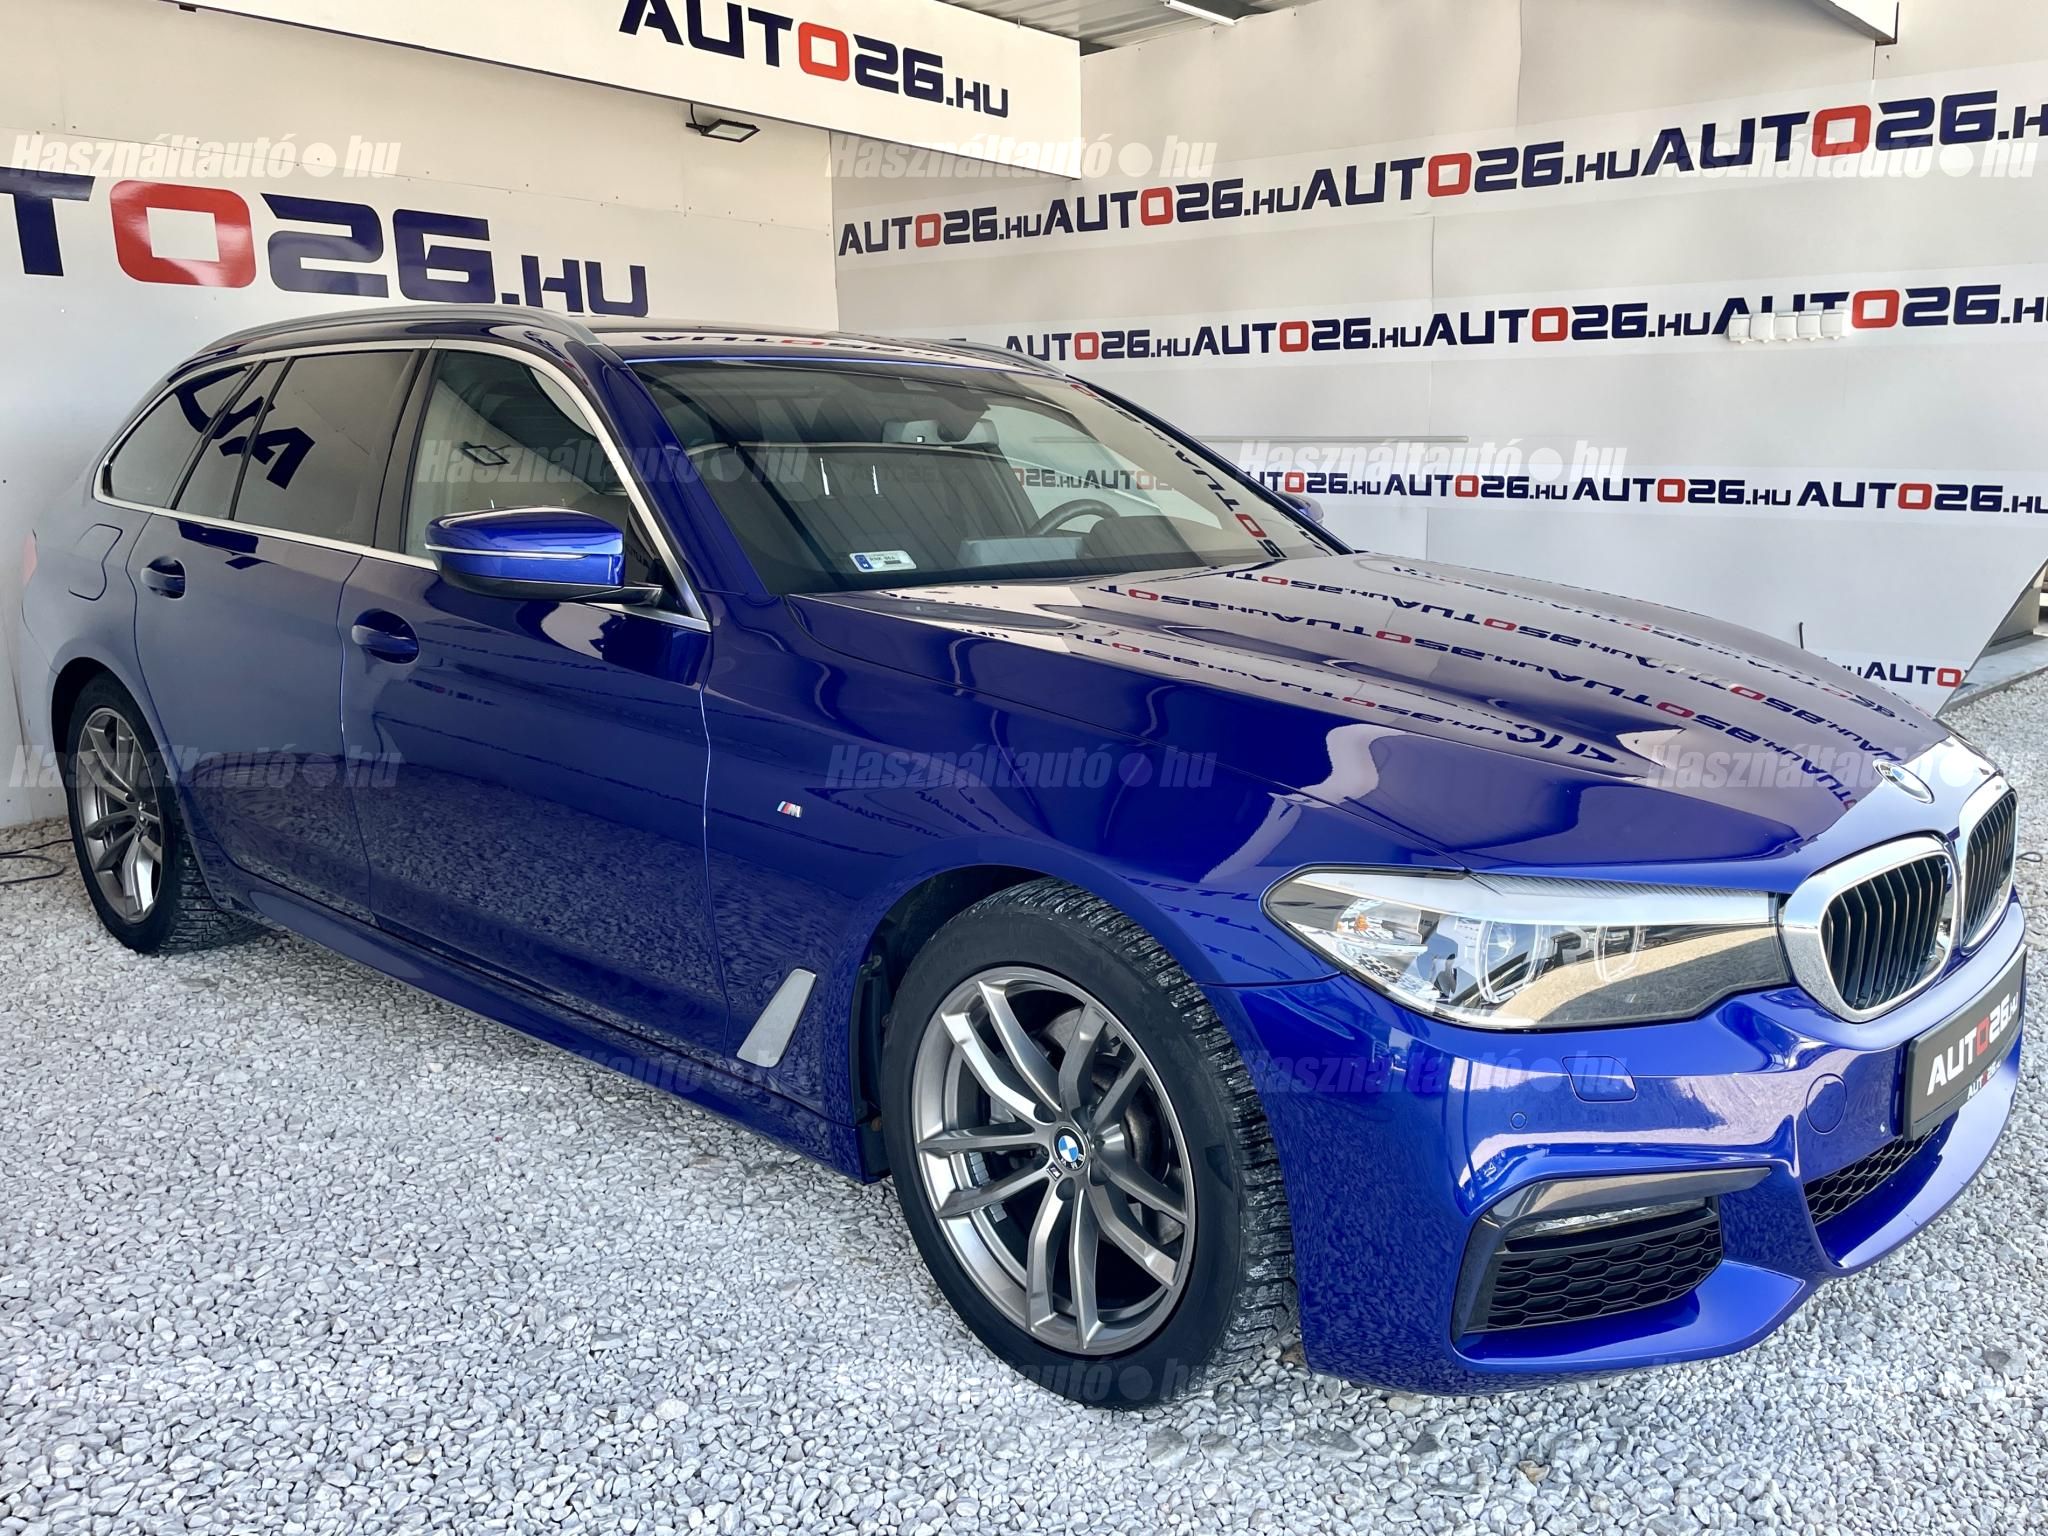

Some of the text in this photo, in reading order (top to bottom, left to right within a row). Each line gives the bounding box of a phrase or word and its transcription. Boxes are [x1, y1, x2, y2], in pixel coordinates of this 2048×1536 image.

[619, 0, 1008, 118] AUTO26.HU
[838, 206, 1042, 256] AUTO26.HU
[1042, 178, 1302, 237] AUTO26.HU
[1302, 141, 1641, 211] AUTO26.HU
[1006, 330, 1191, 361] AUTO26.HU
[1192, 318, 1421, 356] AUTO26.HU
[1423, 302, 1711, 347] AUTO26.HU
[1384, 474, 1567, 500] AUTO26.HU
[1573, 478, 1791, 506] AUTO26.HU
[1797, 482, 2048, 514] AUTO26.HU
[1864, 661, 1964, 688] AUTO
